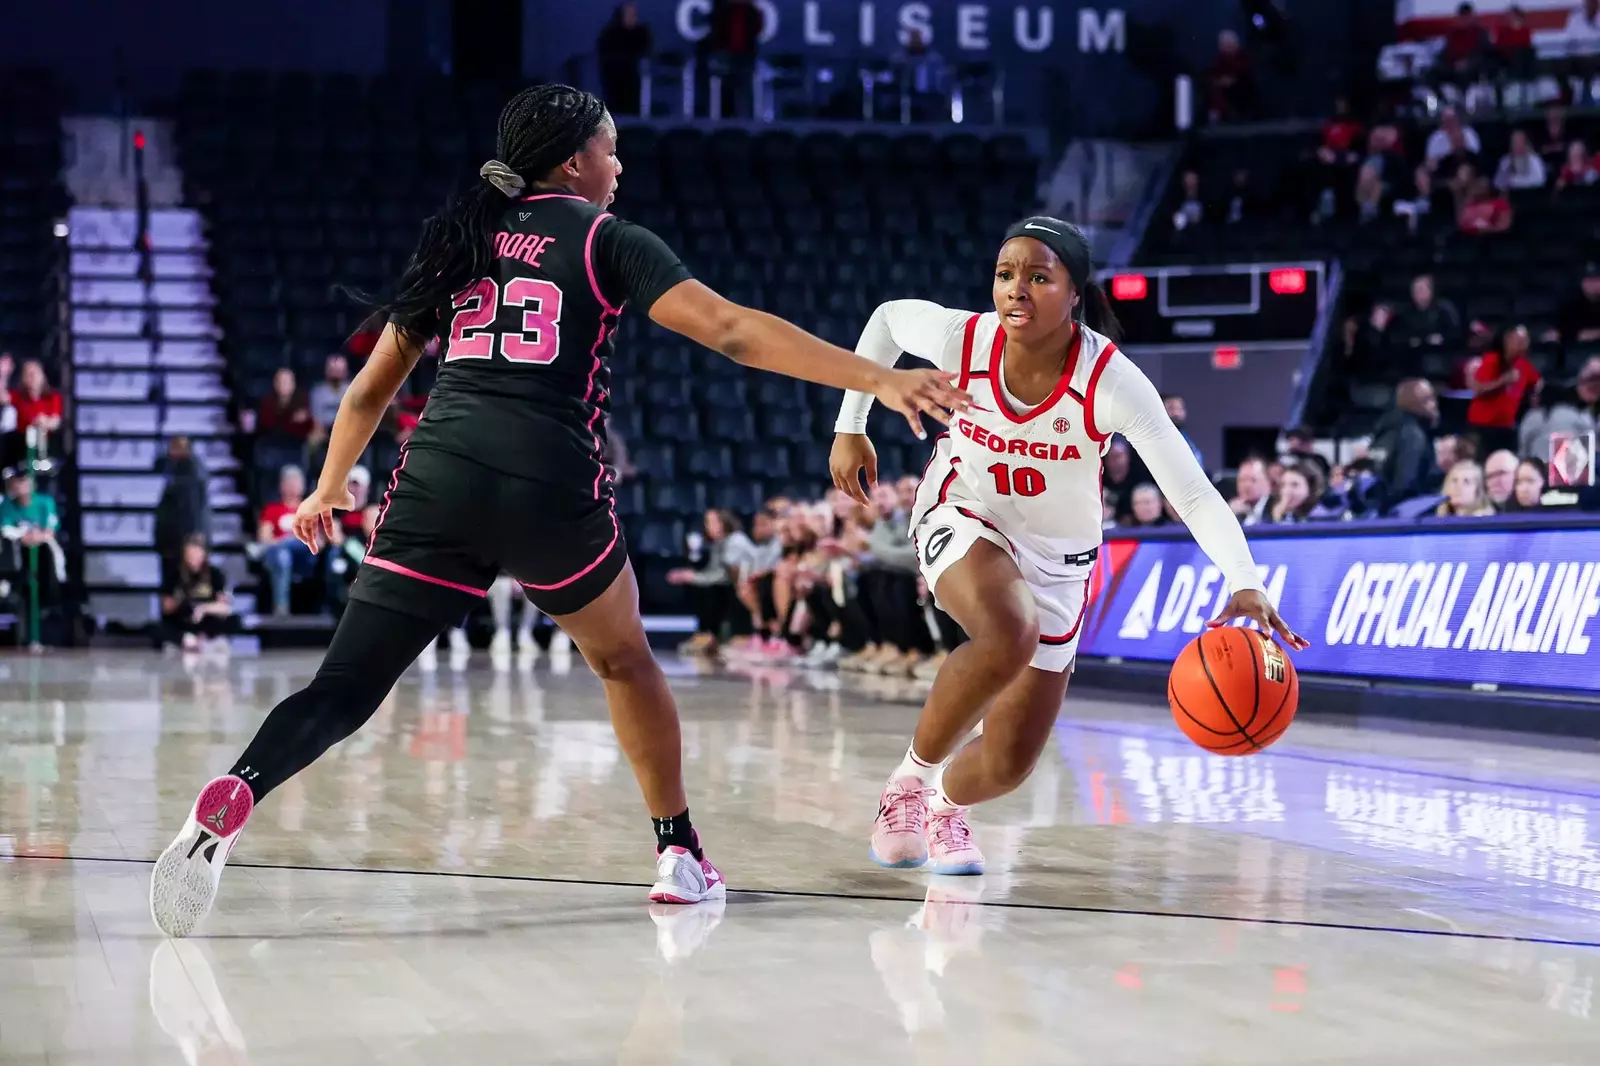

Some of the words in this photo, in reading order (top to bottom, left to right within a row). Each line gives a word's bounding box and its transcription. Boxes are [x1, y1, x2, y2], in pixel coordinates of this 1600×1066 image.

[490, 231, 556, 268] OORE
[445, 277, 563, 365] 23
[958, 418, 1082, 461] GEORGIA
[1054, 418, 1069, 433] SEC
[987, 462, 1047, 497] 10
[924, 525, 955, 568] G
[1325, 561, 1468, 650] OFFICIAL
[1452, 561, 1600, 655] AIRLINE
